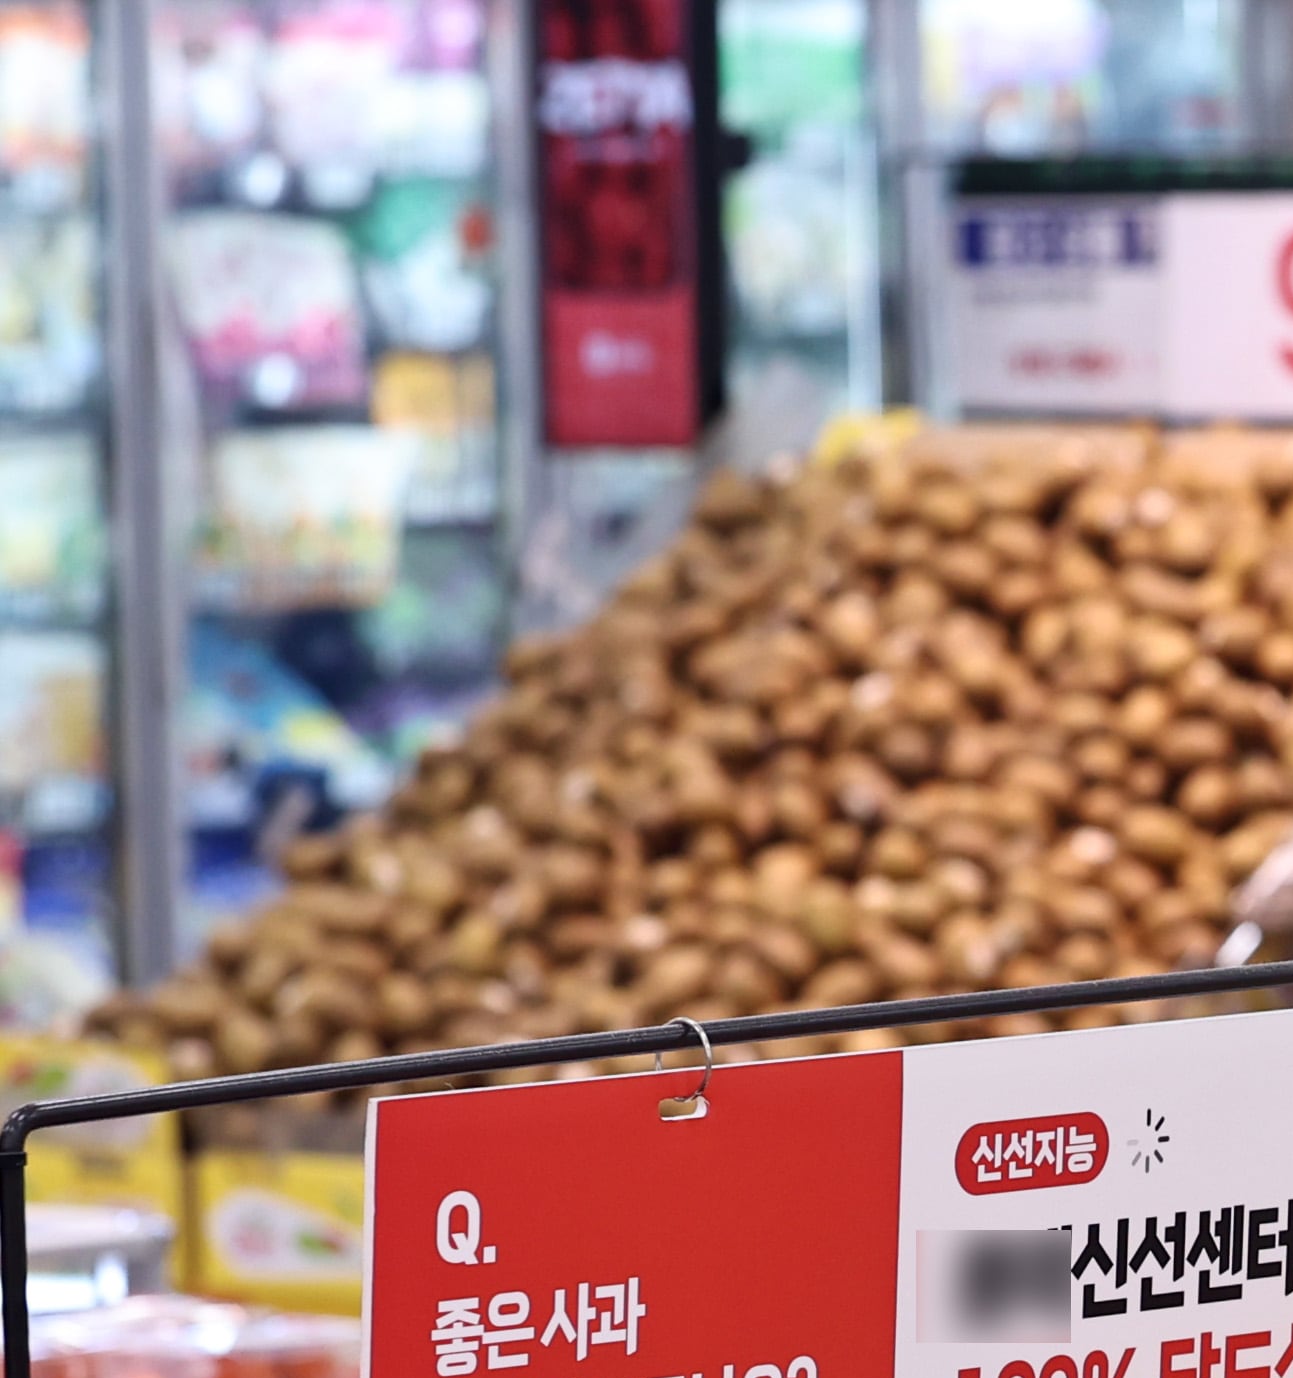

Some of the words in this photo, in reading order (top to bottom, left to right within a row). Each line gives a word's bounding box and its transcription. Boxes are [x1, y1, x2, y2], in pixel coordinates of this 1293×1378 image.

[971, 1125, 1097, 1183] 신선지능
[436, 1190, 496, 1265] Q.
[431, 1291, 535, 1377] 좋은
[541, 1277, 646, 1361] 사과
